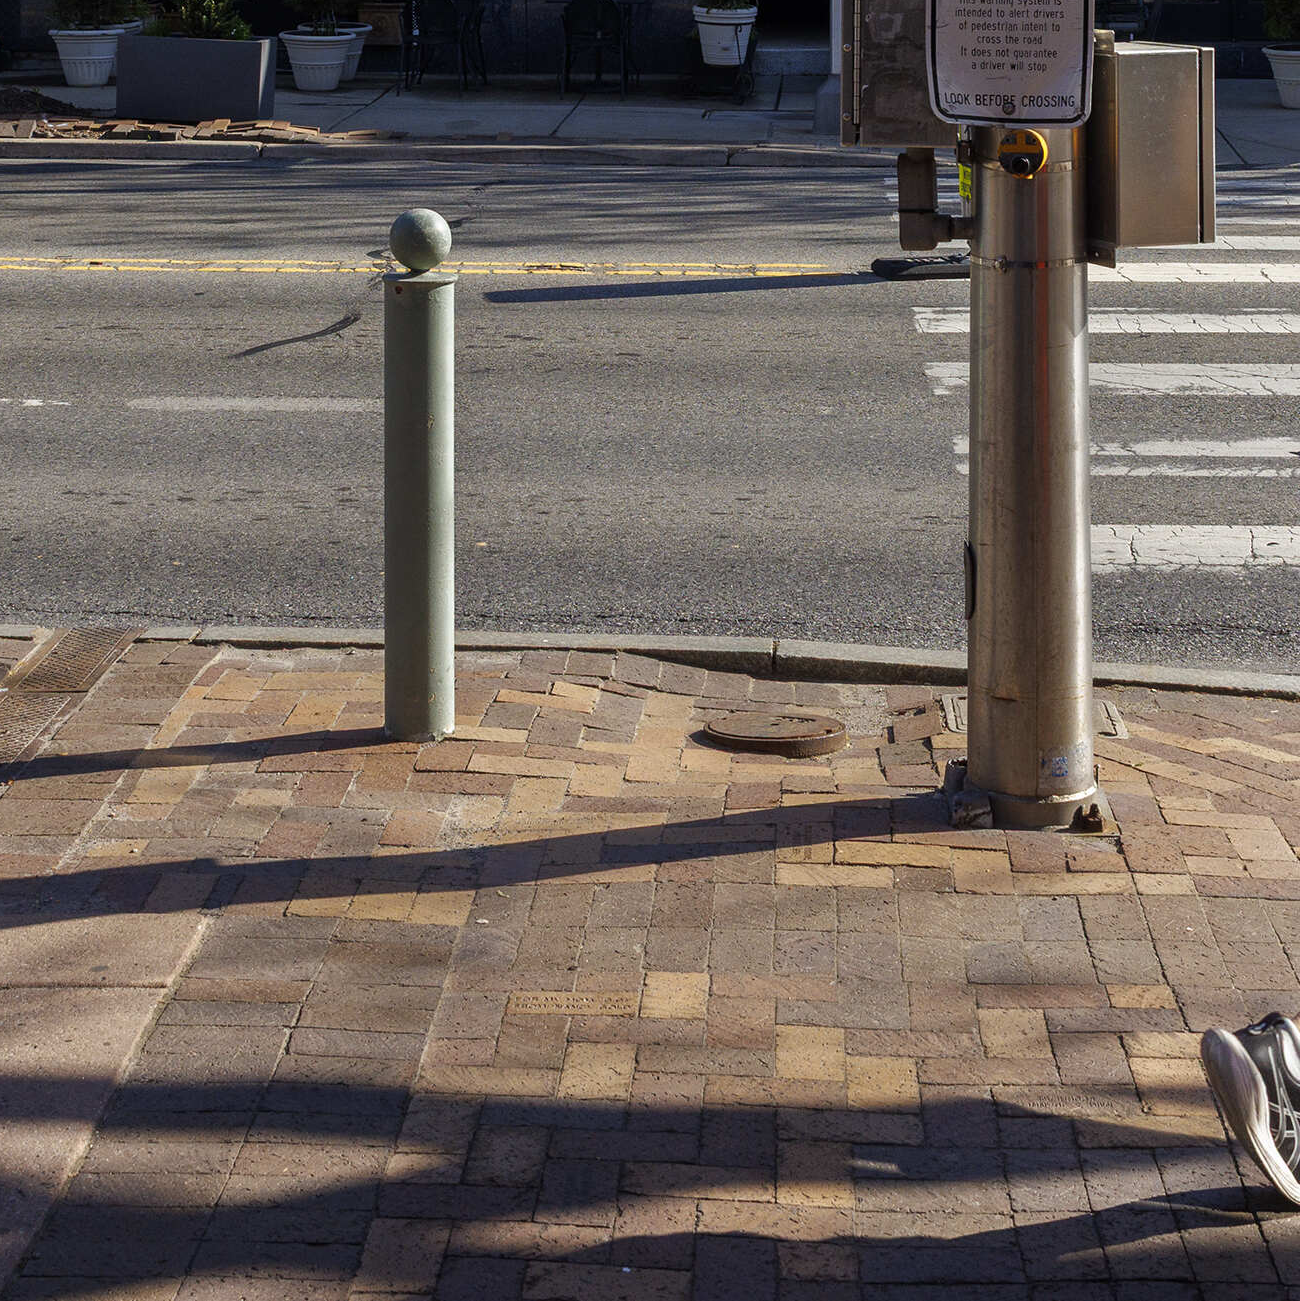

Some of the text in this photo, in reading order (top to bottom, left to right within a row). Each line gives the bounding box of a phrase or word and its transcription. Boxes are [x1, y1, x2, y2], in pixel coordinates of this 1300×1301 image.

[955, 8, 1065, 19] intended to alert drivers
[959, 20, 1060, 32] of pedestrian intent to
[977, 35, 1043, 44] cross the road
[960, 46, 1058, 60] It does not guarantee
[980, 61, 1006, 70] driver
[1010, 62, 1024, 70] will
[1028, 63, 1047, 73] stop
[944, 92, 1075, 108] LOOK BEFORE CROSSING
